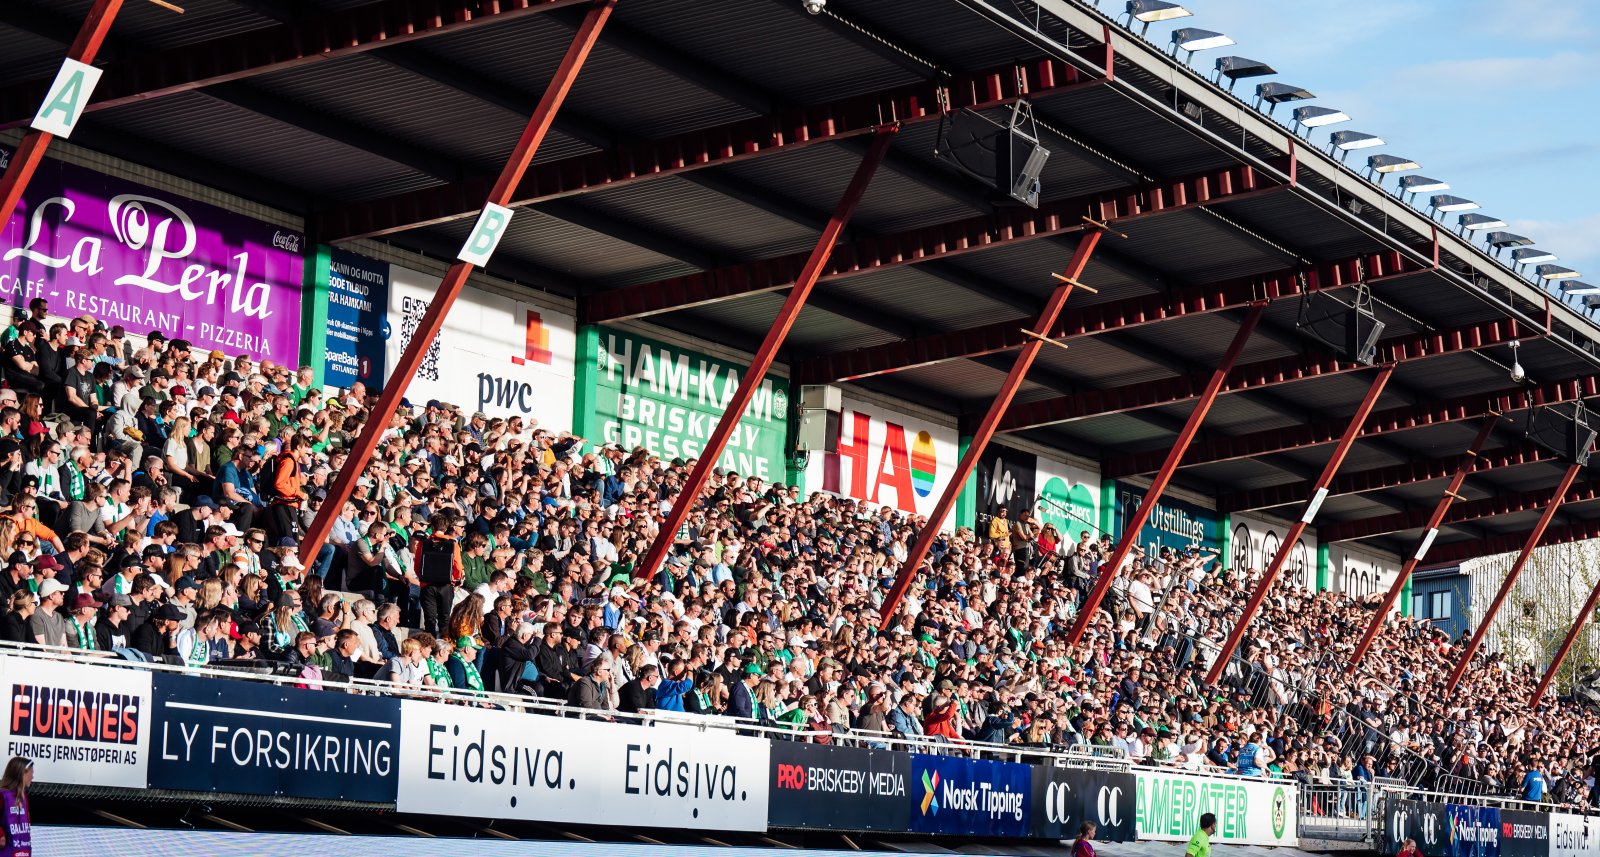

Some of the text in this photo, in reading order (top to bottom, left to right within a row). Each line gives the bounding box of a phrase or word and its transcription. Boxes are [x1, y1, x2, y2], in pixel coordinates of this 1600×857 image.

[40, 70, 85, 127] A
[467, 209, 505, 257] B
[3, 194, 273, 320] La Perla
[350, 267, 361, 279] OG
[361, 270, 384, 286] MOTTA
[340, 294, 372, 313] HAMKAM!
[346, 281, 369, 296] TILBUD
[0, 275, 44, 300] CAFÉ
[66, 289, 181, 332] RESTAURANT
[200, 322, 271, 356] PIZZERIA
[325, 348, 368, 374] SpareBank 1
[607, 334, 773, 423] HAM-KAM
[476, 372, 532, 413] pwc
[617, 392, 760, 451] BRISKEBY
[603, 421, 770, 482] GRESSANE
[1044, 492, 1092, 524] Specsavers
[1150, 503, 1204, 549] Utstillings
[11, 684, 139, 743] FURNES
[8, 741, 137, 765] FURNES JERNSTØPERI AS
[162, 721, 391, 777] LY FORSIKRING
[869, 772, 906, 797] MEDIA
[943, 779, 1023, 821] Norsk Tipping
[9, 822, 31, 835] BALLH
[1136, 776, 1248, 839] AMERATER
[1459, 819, 1498, 848] Norsk Tipping
[1534, 825, 1548, 840] MEDIA
